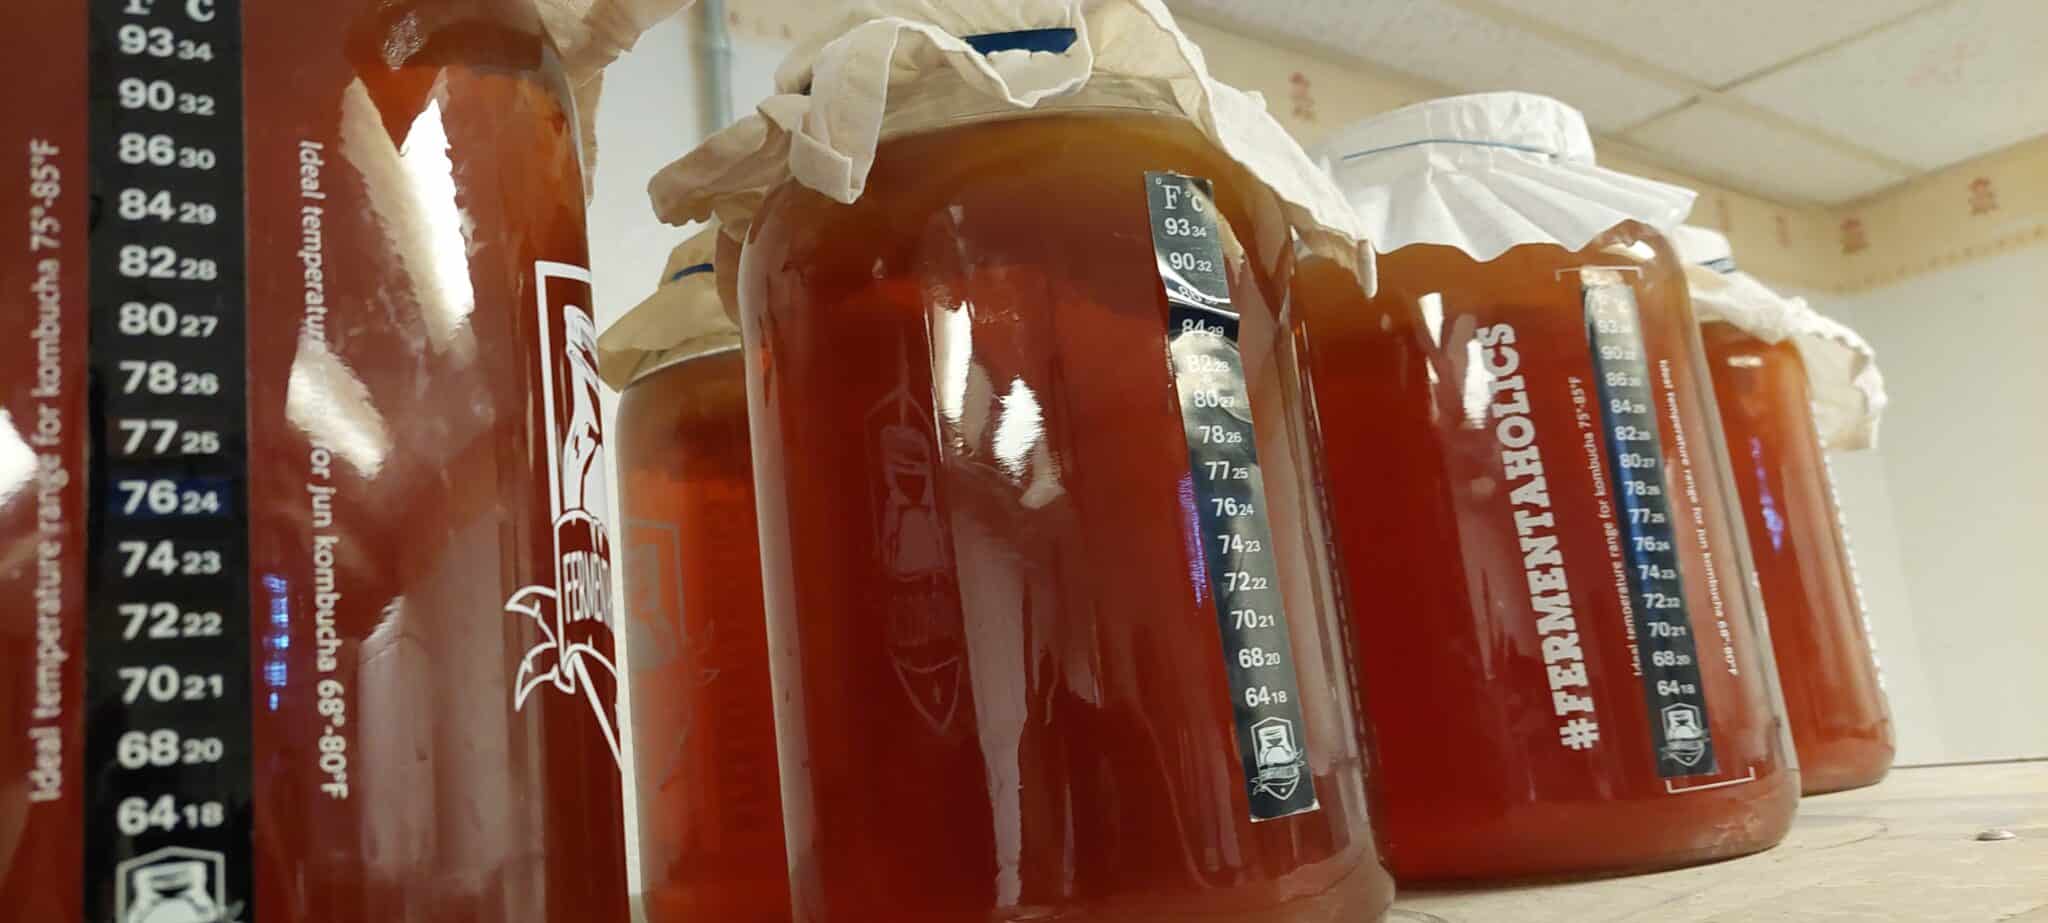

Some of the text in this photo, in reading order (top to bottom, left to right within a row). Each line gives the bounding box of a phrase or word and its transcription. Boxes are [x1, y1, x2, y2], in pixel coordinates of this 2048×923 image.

[119, 24, 214, 61] 93 34
[118, 78, 215, 116] 90 32
[119, 132, 216, 170] 86 30
[299, 140, 327, 198] Ideal
[119, 188, 217, 225] 84 29
[1164, 217, 1207, 237] 93 34
[119, 245, 218, 281] 82 28
[1169, 252, 1212, 272] 90 32
[31, 259, 61, 397] kombucha
[119, 302, 219, 338] 80 27
[1182, 318, 1205, 334] 84
[119, 360, 219, 395] 78 26
[1193, 390, 1218, 408] 80
[1610, 399, 1631, 414] 84
[30, 404, 61, 446] for
[119, 419, 220, 454] 77 25
[1200, 425, 1242, 444] 78 26
[1615, 426, 1635, 441] 82
[1205, 461, 1248, 480] 77 25
[1584, 432, 1607, 497] kombucha
[1619, 453, 1640, 468] 80
[37, 454, 69, 531] range
[118, 479, 220, 514] 76 24
[307, 483, 336, 527] jun
[1624, 481, 1645, 496] 78
[1211, 497, 1254, 516] 76 24
[1597, 500, 1611, 519] for
[1629, 508, 1650, 524] 77
[1218, 534, 1261, 554] 74 23
[1477, 323, 1600, 750] #FERMENTAHOLICS
[1603, 522, 1620, 558] range
[1632, 536, 1655, 552] 76
[118, 540, 222, 576] 74 23
[1637, 564, 1660, 580] 74
[1224, 572, 1268, 591] 72 22
[314, 535, 342, 672] kombucha
[1612, 561, 1636, 641] temperature
[1642, 592, 1665, 608] 72
[33, 542, 69, 718] temperature
[118, 602, 222, 640] 72 22
[1231, 609, 1275, 629] 70 21
[1647, 621, 1670, 637] 70
[1238, 648, 1280, 668] 68 20
[1652, 650, 1675, 666] 68
[118, 665, 223, 704] 70 21
[1245, 686, 1287, 708] 64 18
[1657, 679, 1680, 696] 64
[28, 726, 61, 802] Ideal
[117, 729, 224, 769] 68 20
[117, 794, 224, 836] 64 18
